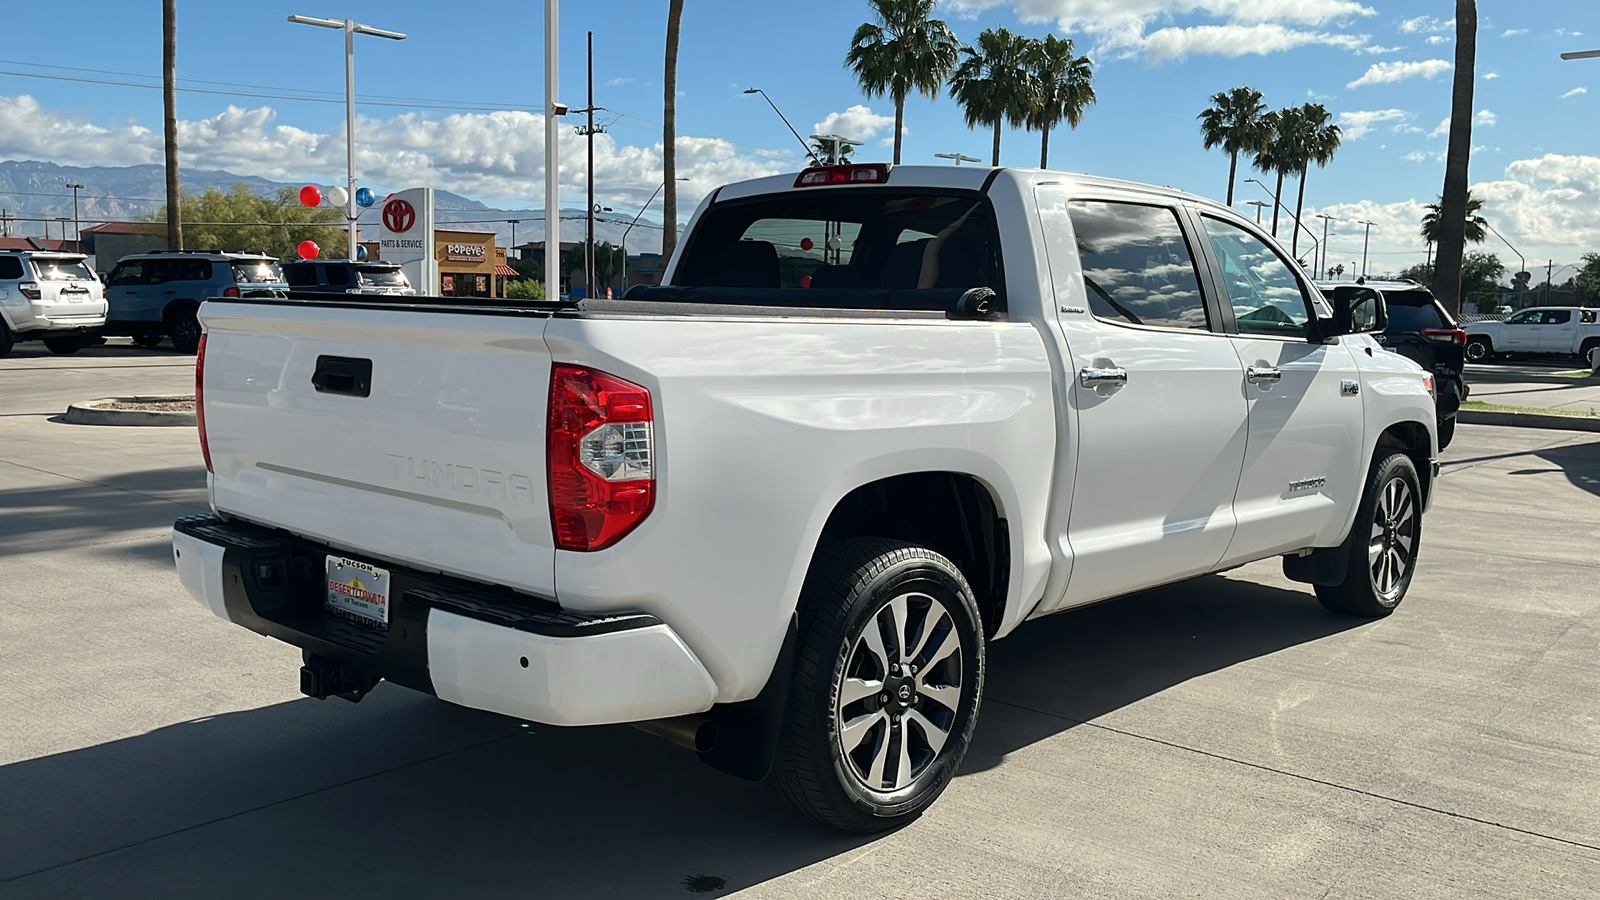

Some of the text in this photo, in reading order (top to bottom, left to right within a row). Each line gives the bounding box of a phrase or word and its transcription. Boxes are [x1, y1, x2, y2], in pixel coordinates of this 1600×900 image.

[381, 239, 422, 249] PARTS & SERVICE
[385, 453, 534, 505] TUNDRA
[341, 558, 373, 572] TUCSON
[329, 580, 386, 606] DESERT TOYOTA
[351, 598, 369, 609] Tucson
